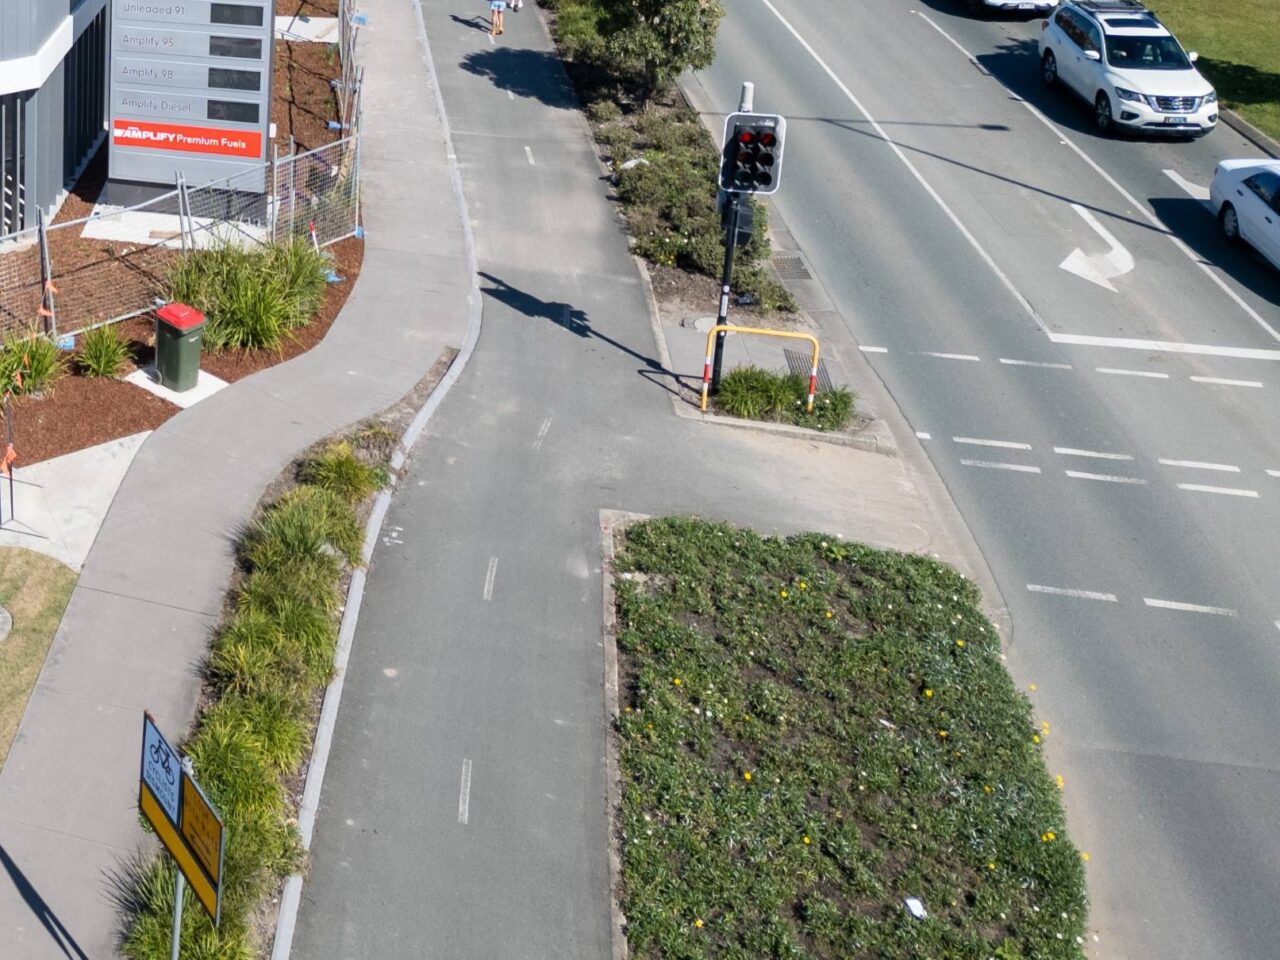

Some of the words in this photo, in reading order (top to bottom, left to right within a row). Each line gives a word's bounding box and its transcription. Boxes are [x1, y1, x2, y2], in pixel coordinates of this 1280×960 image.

[123, 3, 172, 15] Unleaded
[174, 6, 185, 15] 91
[122, 34, 159, 47] Amplify
[122, 66, 158, 79] Amplify
[161, 69, 173, 79] 98
[121, 97, 158, 110] Amplify
[161, 100, 192, 112] Diesel
[122, 128, 176, 142] AMPLIFY
[176, 135, 219, 146] Premium
[221, 137, 247, 149] Fuels
